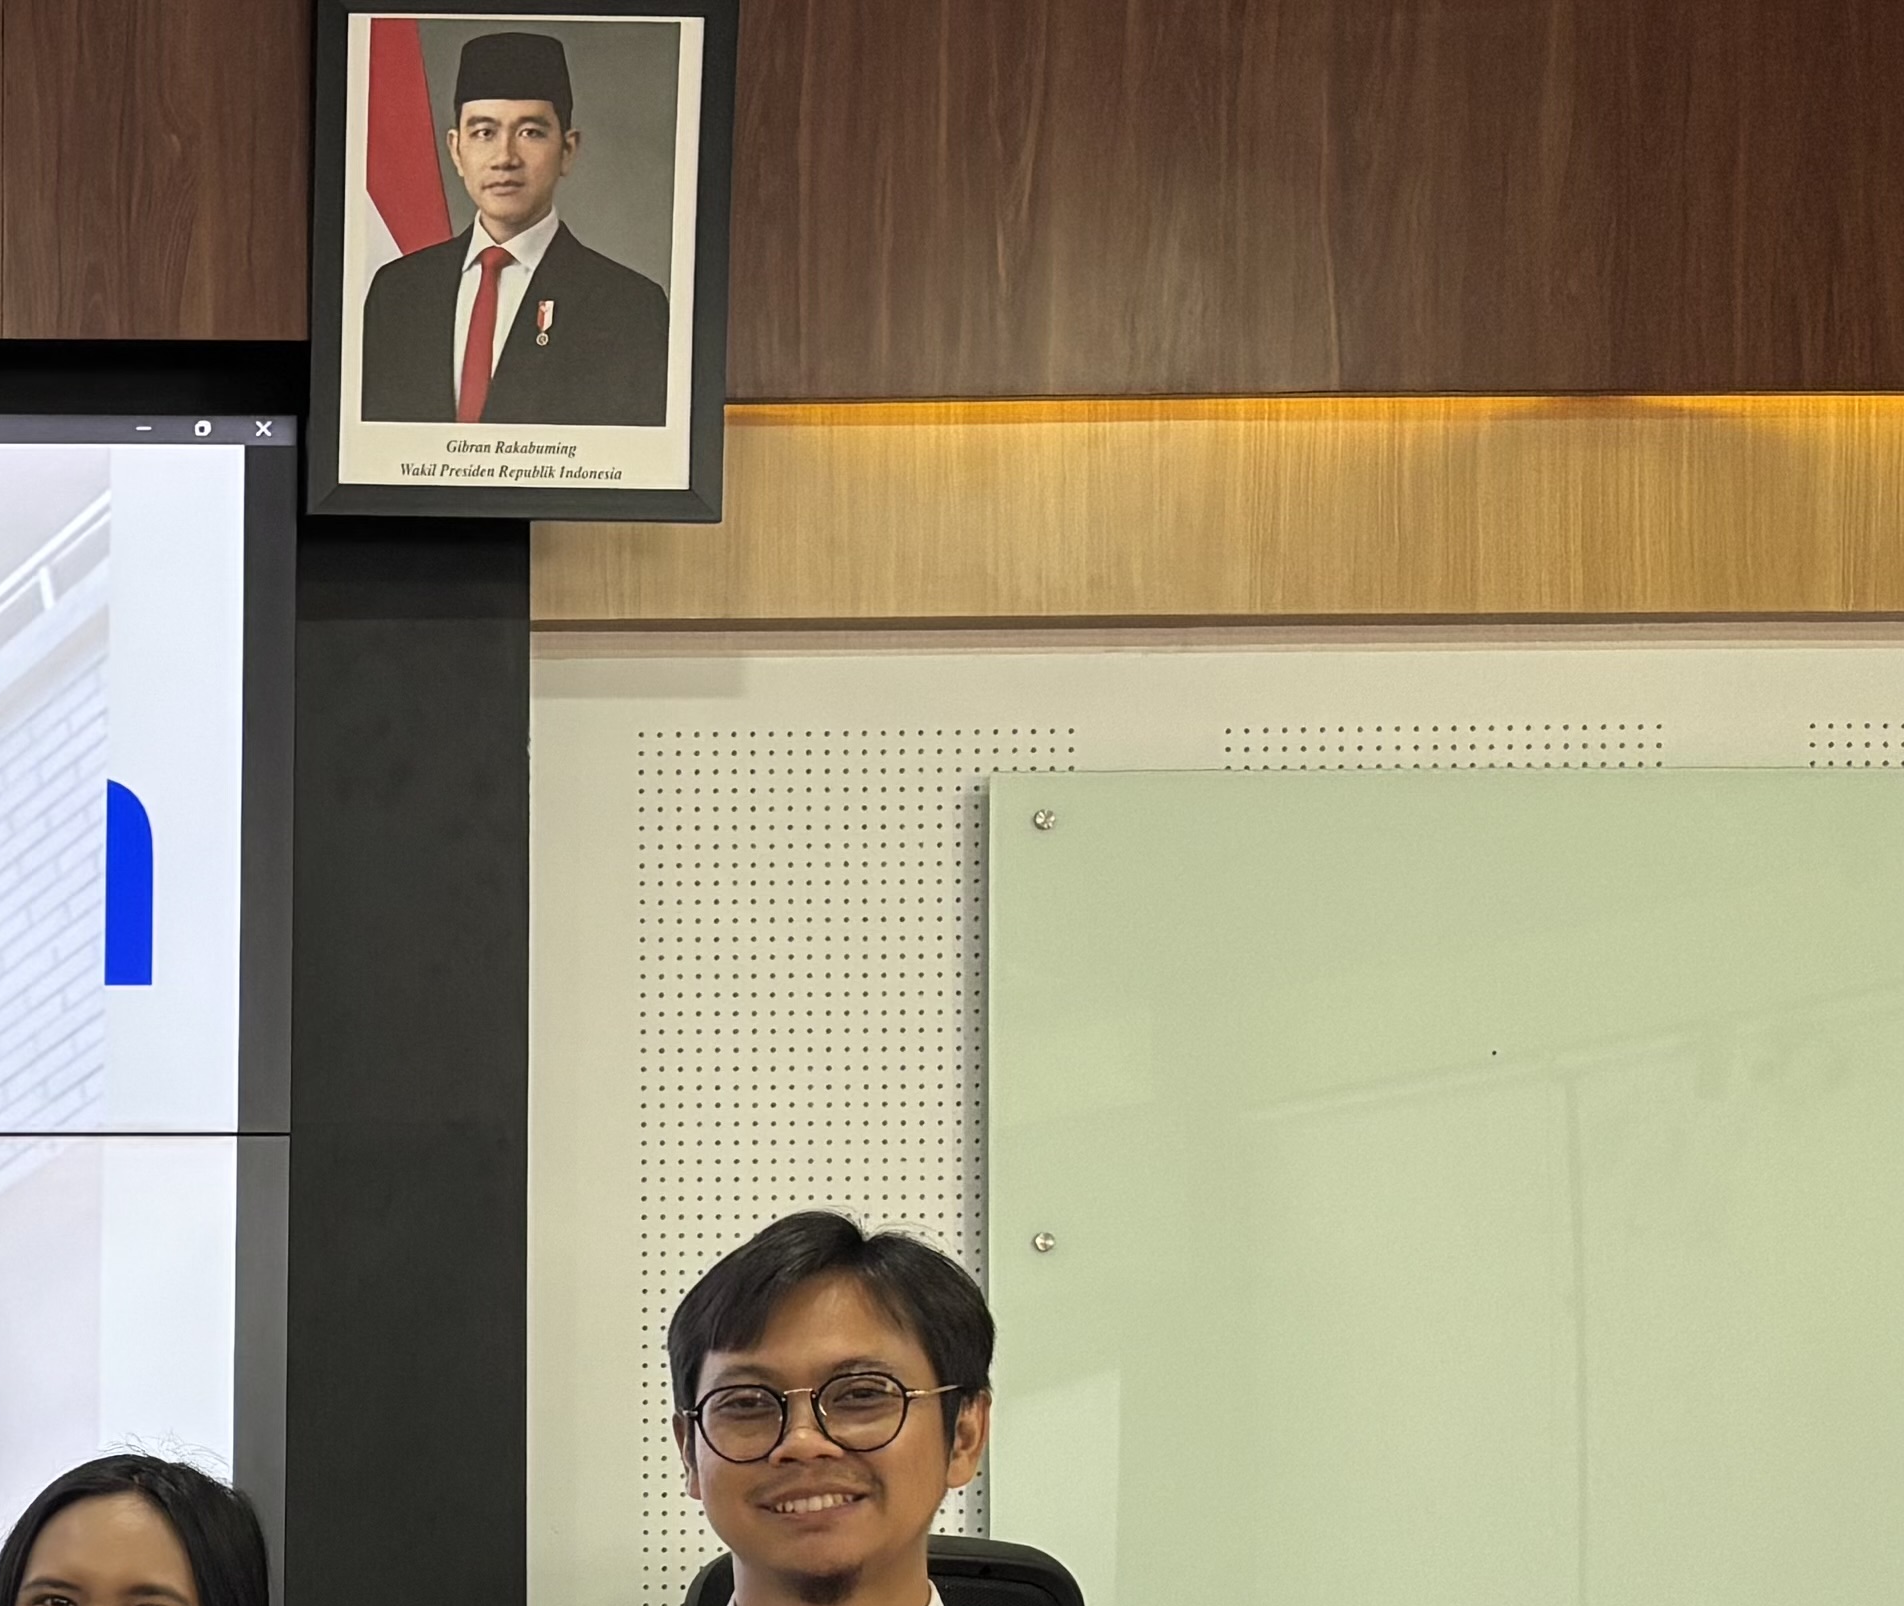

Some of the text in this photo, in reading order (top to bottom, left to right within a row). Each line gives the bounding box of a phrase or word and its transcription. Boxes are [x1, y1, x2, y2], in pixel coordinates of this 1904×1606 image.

[446, 439, 577, 458] Gibran Rakabuming
[400, 462, 623, 482] Wakil Presiden Republik Indonesia
